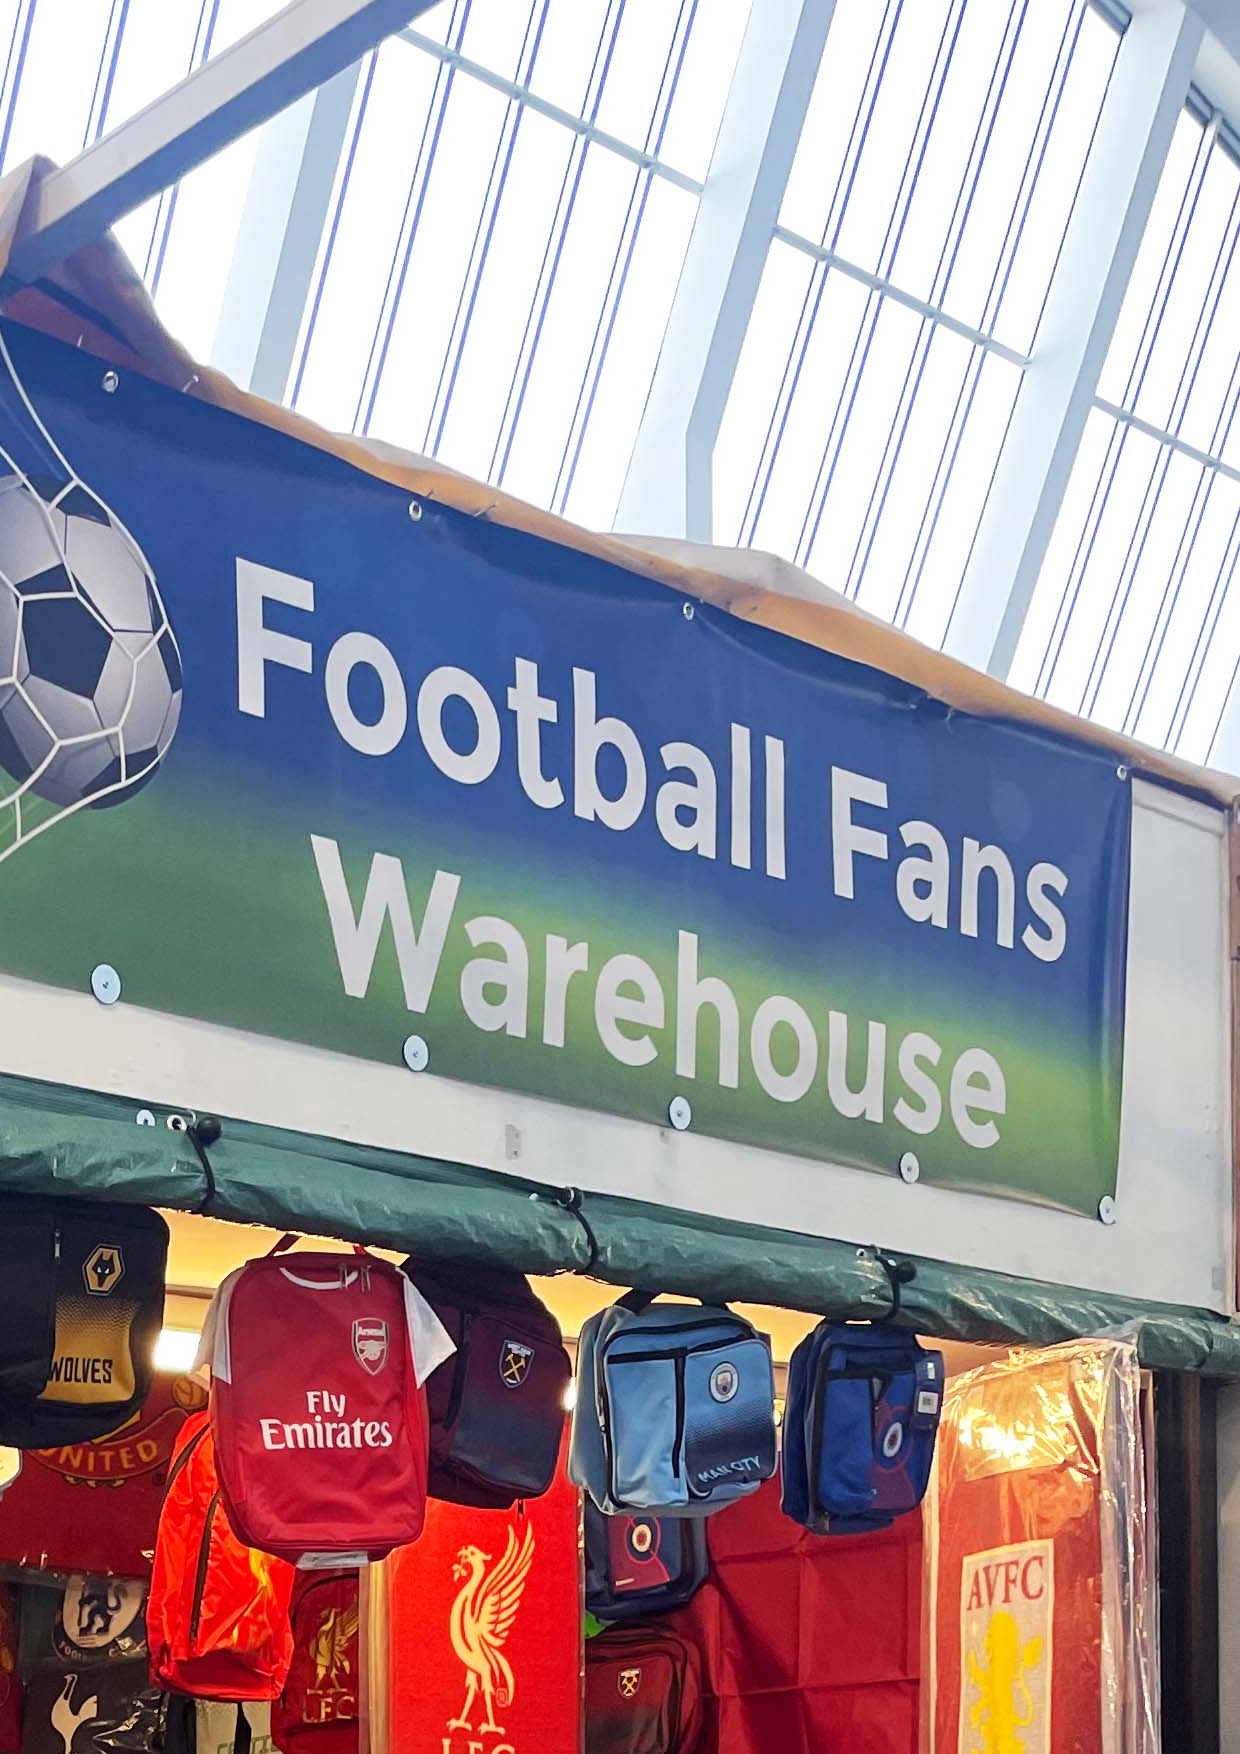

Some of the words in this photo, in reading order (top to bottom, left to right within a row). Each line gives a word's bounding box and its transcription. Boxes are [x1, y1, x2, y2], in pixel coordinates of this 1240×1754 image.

[235, 556, 787, 880] Football
[831, 765, 1069, 962] Fans
[310, 834, 1007, 1149] Warehouse
[50, 1356, 114, 1384] WOLVES
[306, 1390, 346, 1418] Fly
[259, 1415, 393, 1450] Emirates
[698, 1464, 728, 1483] MAN
[729, 1455, 761, 1477] CITY
[966, 1555, 1044, 1611] AVFC
